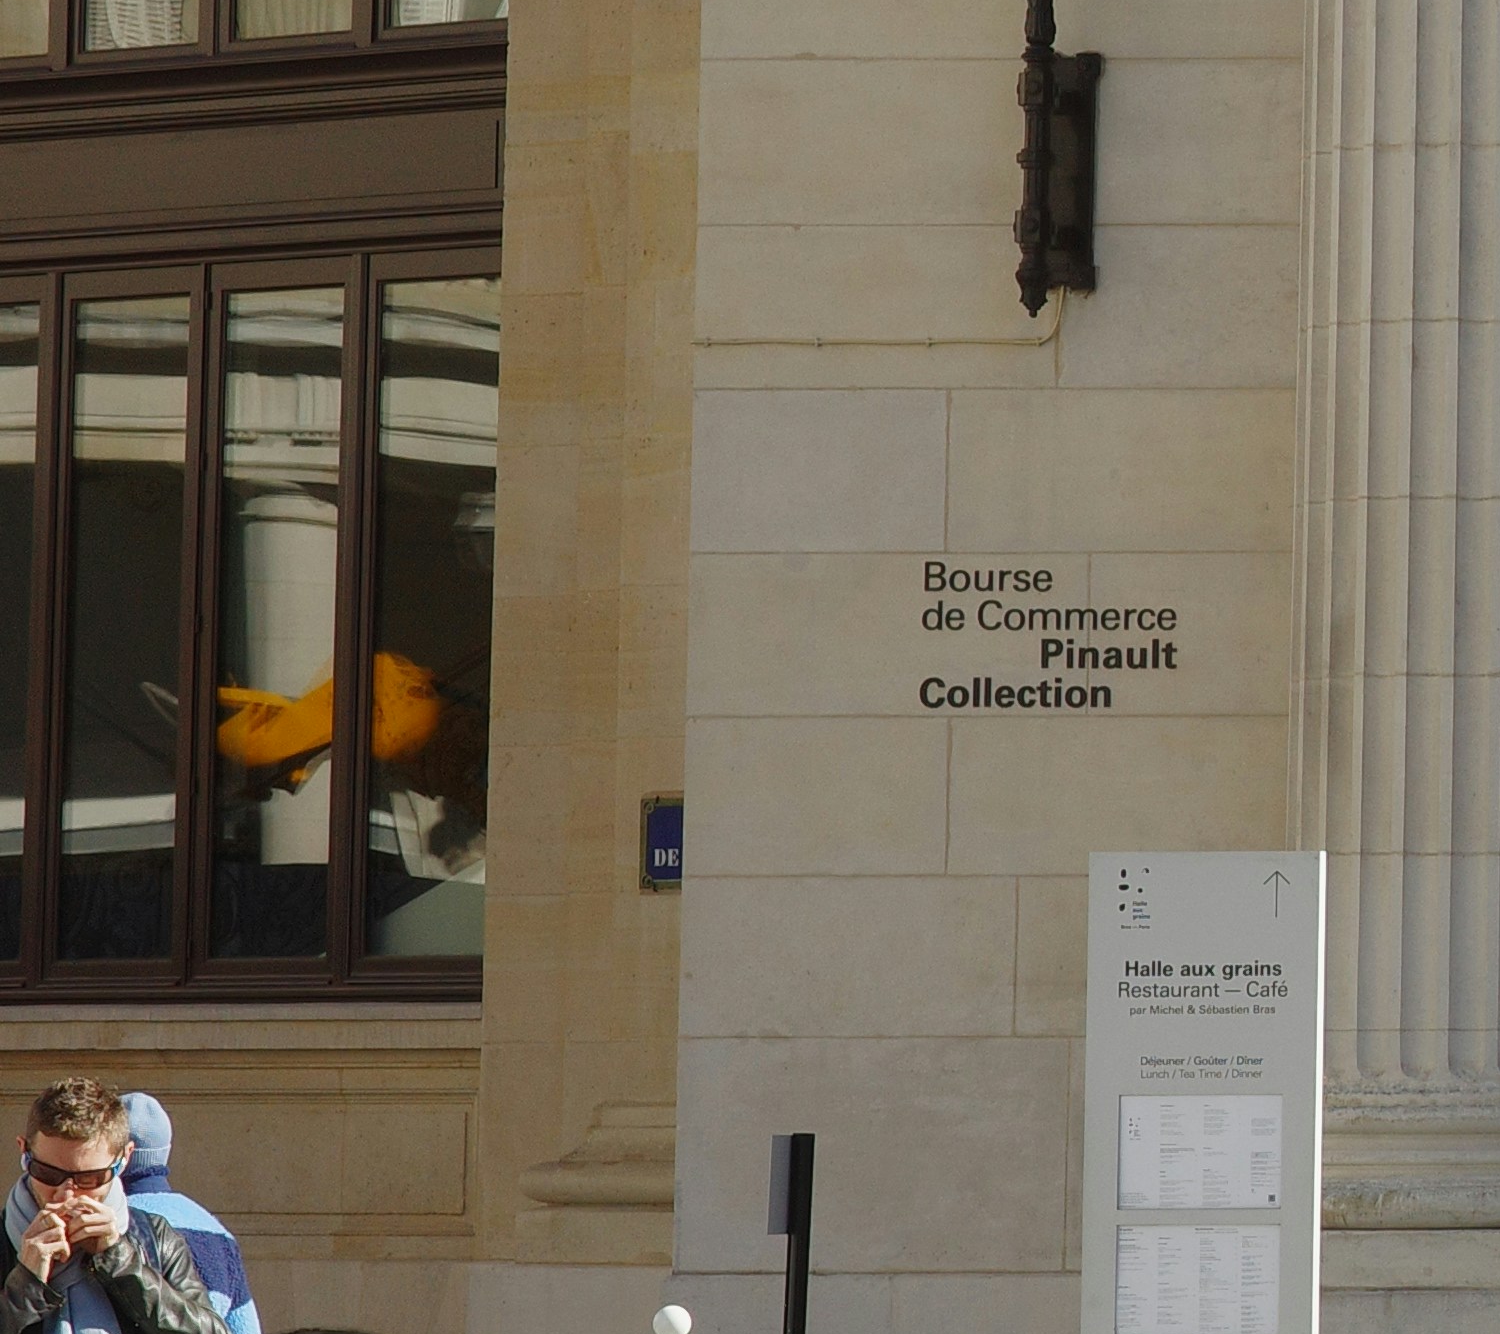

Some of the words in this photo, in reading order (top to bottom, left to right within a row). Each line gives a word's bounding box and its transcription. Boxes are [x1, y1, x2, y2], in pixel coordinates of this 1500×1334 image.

[924, 561, 1053, 592] Bourse
[921, 600, 965, 631] de
[977, 600, 1177, 631] Commerce
[1040, 638, 1178, 669] Pinault
[919, 677, 1112, 709] Collection
[654, 848, 679, 867] DE
[1125, 960, 1174, 977] Halle
[1180, 964, 1215, 977] aux
[1221, 960, 1282, 980] grains
[1118, 981, 1220, 998] Restaurant
[1246, 980, 1288, 998] Café
[1129, 1006, 1147, 1016] par
[1150, 1004, 1184, 1015] Michel
[1187, 1005, 1196, 1014] &
[1199, 1004, 1250, 1015] Sébastien
[1253, 1005, 1276, 1014] Bras
[1193, 1055, 1228, 1066] Goûter
[1140, 1069, 1169, 1079] Lunch
[1179, 1069, 1195, 1079] Tea
[1199, 1069, 1222, 1079] Time
